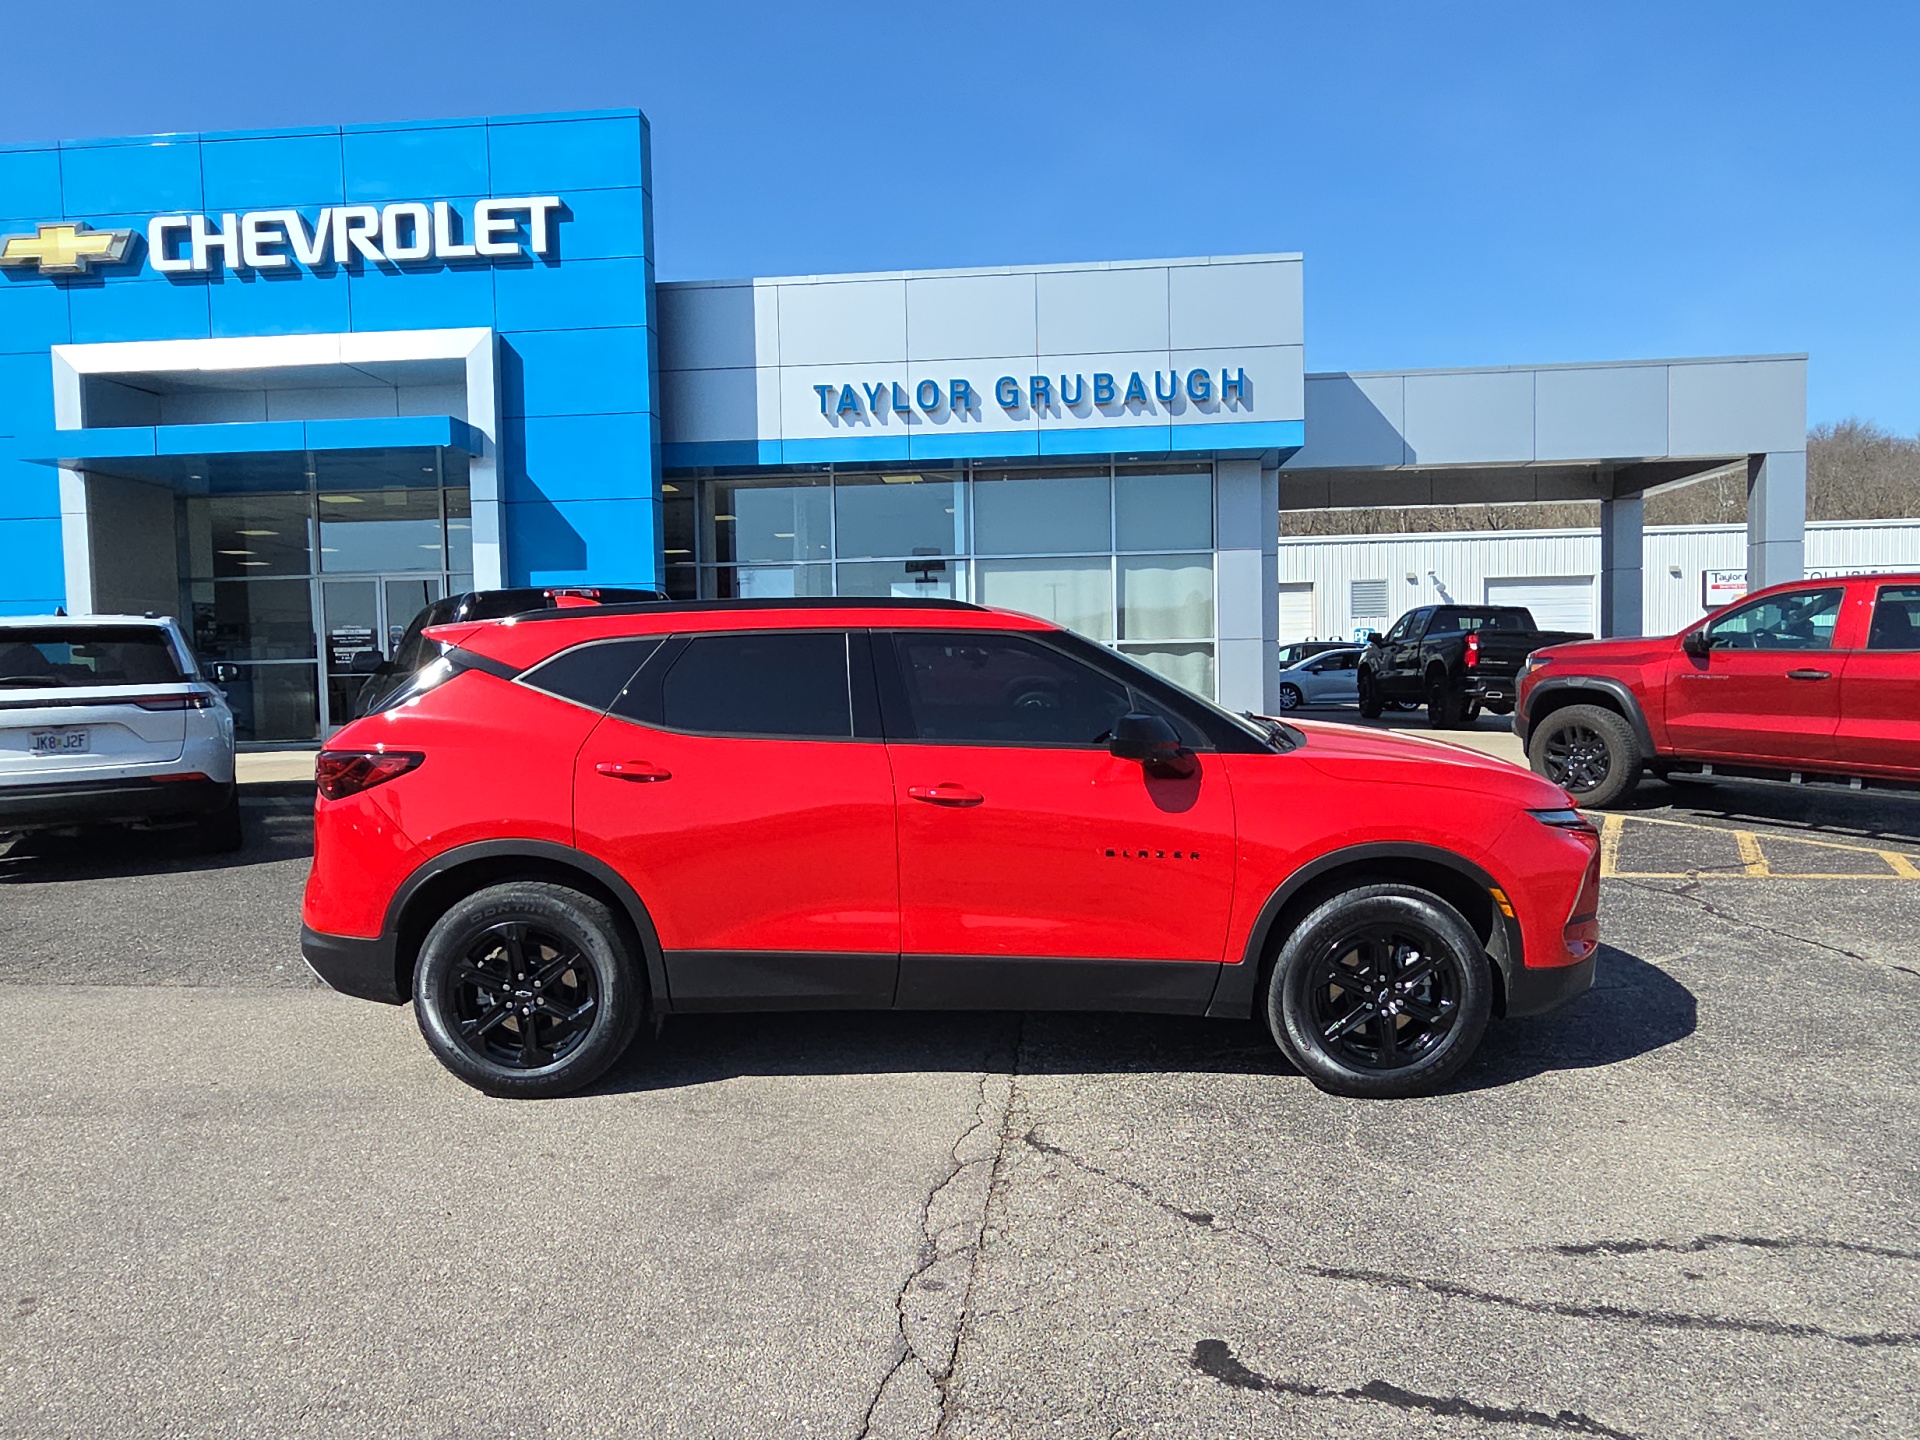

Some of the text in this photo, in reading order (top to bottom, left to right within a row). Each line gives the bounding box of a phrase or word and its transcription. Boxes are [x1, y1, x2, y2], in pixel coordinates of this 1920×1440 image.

[147, 195, 562, 273] CHEVROLET
[813, 367, 1245, 416] TAYLOR GRUBAUGH
[1711, 572, 1743, 583] Taylor
[33, 733, 86, 750] JK8 J2F
[1105, 849, 1200, 860] BLAZER
